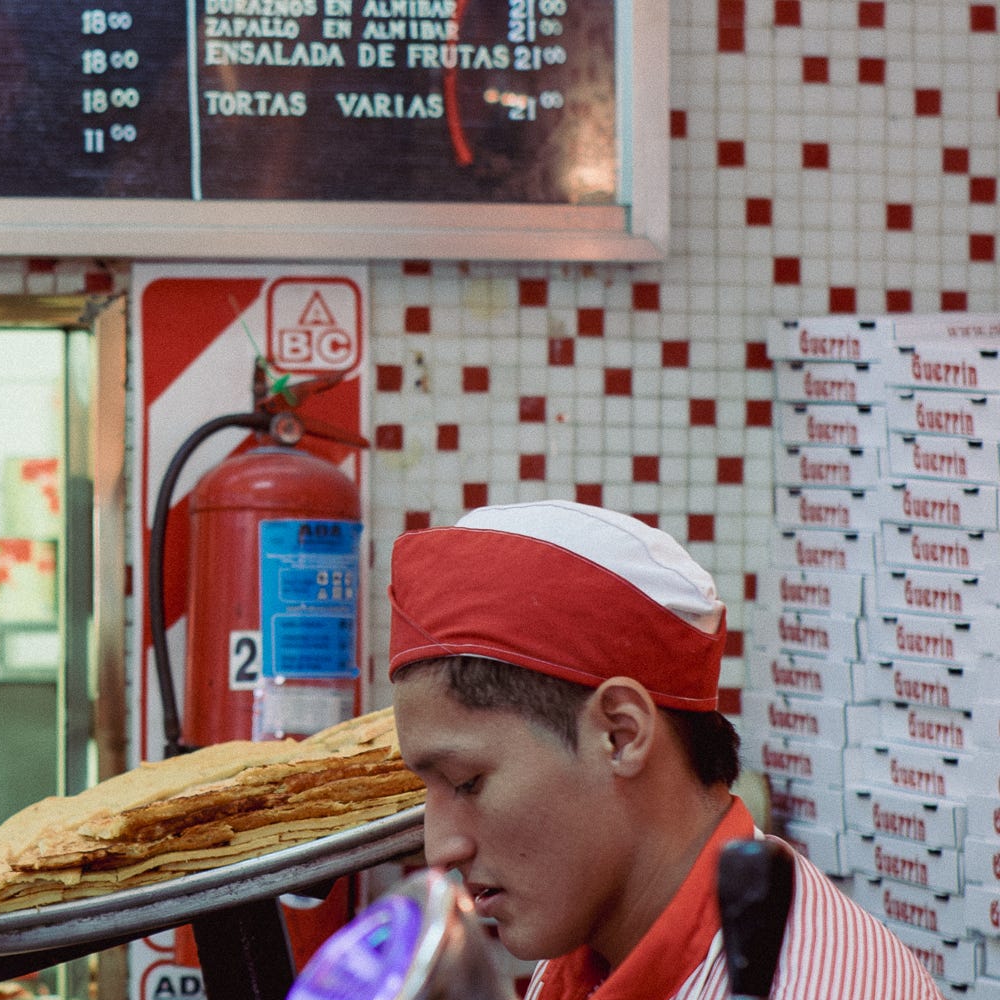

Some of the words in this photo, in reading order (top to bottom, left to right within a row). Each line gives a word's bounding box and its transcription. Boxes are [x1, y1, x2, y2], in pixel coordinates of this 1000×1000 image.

[206, 17, 300, 39] ZAPALLO
[324, 20, 352, 39] EN
[364, 19, 460, 41] ALMIBAR
[206, 41, 345, 67] ENSALADA
[359, 44, 395, 68] DE
[408, 44, 510, 69] FRUTAS
[205, 92, 307, 117] TORTAS
[337, 94, 444, 119] VARIAS
[911, 354, 978, 387] Guerrin
[915, 402, 975, 435] Guerrin
[912, 444, 968, 478] Guerrin
[902, 489, 961, 525] Guerrin
[911, 534, 970, 568] Guerrin
[904, 578, 963, 614] Guerrin
[235, 637, 257, 682] 2
[896, 623, 955, 660] Guerrin
[893, 671, 950, 707] Guerrin
[907, 709, 965, 748] Guerrin
[889, 758, 946, 795] Guerrin
[872, 802, 926, 840] Guerrin
[874, 845, 928, 885] Guerrin
[883, 889, 937, 931] Guerrin
[155, 976, 203, 996] AD
